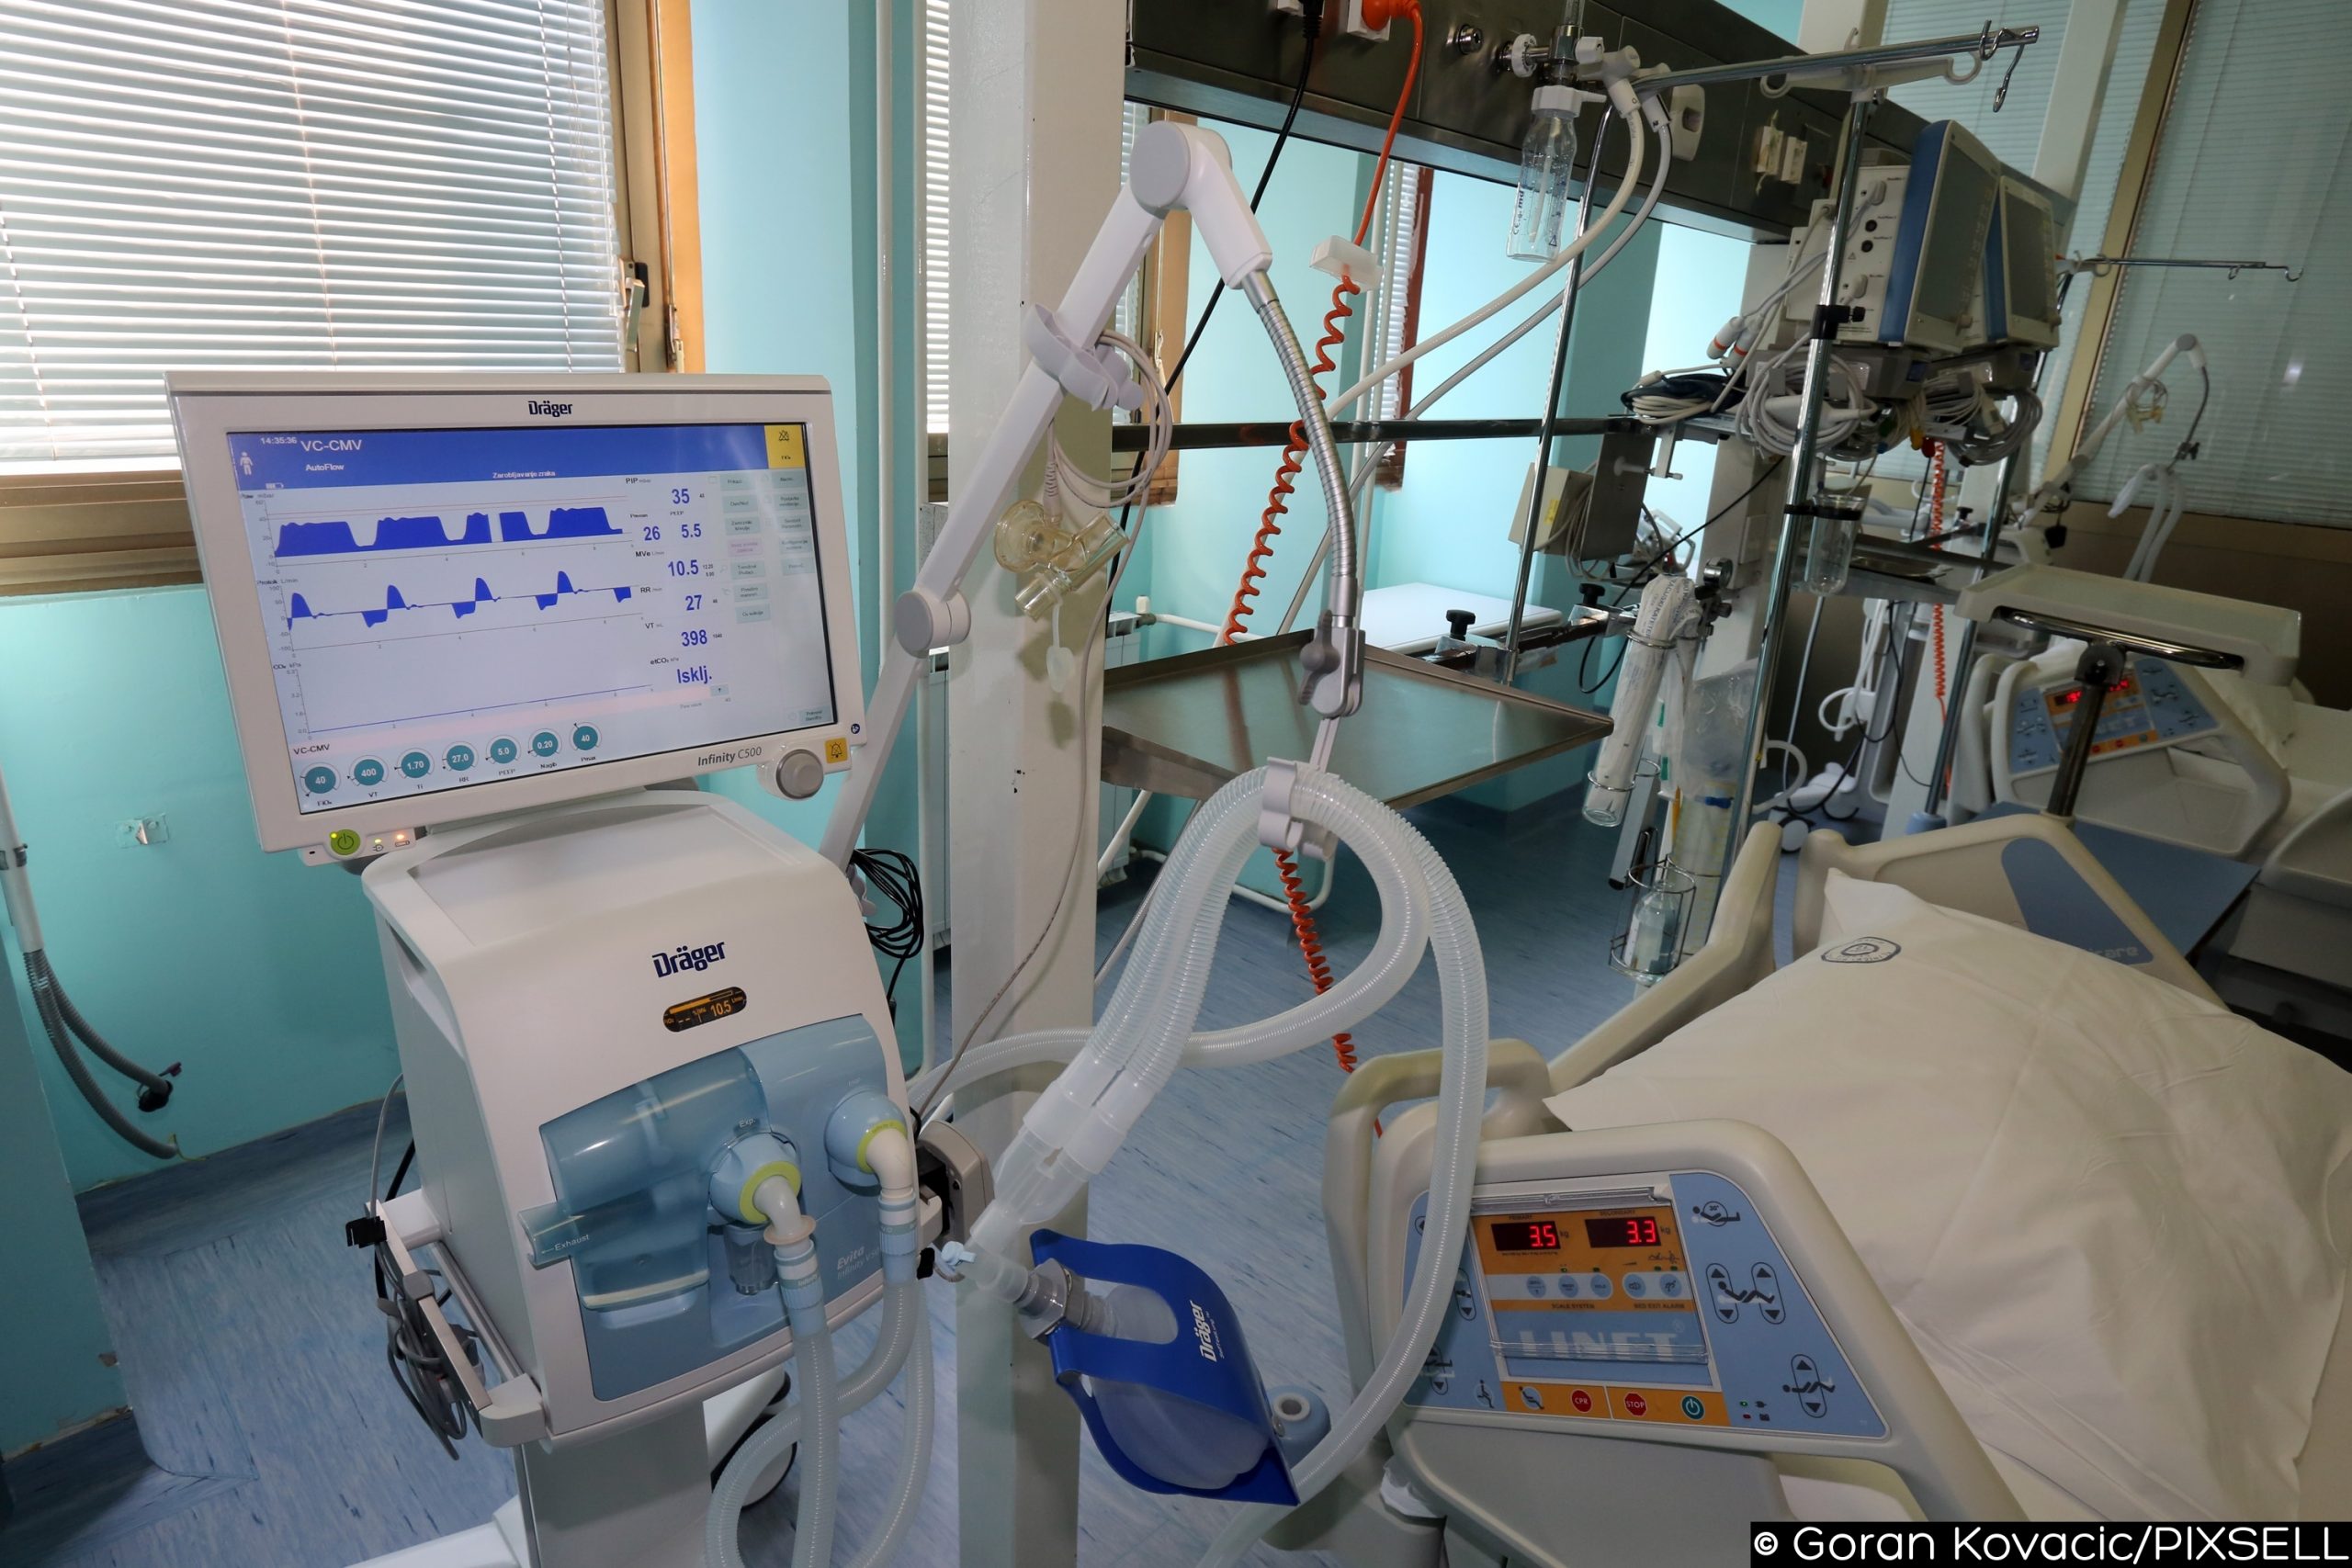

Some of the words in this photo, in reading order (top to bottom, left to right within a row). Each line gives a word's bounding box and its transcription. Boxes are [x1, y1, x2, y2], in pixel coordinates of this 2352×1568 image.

[527, 400, 573, 418] Dräger
[261, 436, 298, 446] 14:35:36
[300, 439, 363, 452] VC-CMV
[305, 462, 345, 472] AutoFlow
[672, 488, 690, 504] 35
[643, 525, 661, 541] 26
[681, 523, 702, 538] 5.5
[668, 558, 699, 577] 10.5
[684, 594, 702, 611] 27
[681, 629, 707, 647] 398
[676, 665, 712, 684] Isklj.
[537, 739, 553, 750] 0.20
[581, 734, 591, 742] 40
[293, 743, 331, 755] VC-CMV
[497, 747, 510, 756] 5.0
[451, 753, 469, 763] 27.0
[697, 751, 736, 767] Infinity
[737, 746, 763, 761] C500
[360, 768, 377, 777] 400
[406, 760, 425, 771] 1.70
[314, 775, 326, 785] 40
[651, 942, 726, 978] Dräger
[710, 999, 732, 1017] 10.5
[739, 1118, 756, 1129] Exp.
[1626, 1219, 1657, 1244] 3.3
[1660, 1226, 1671, 1235] kg
[554, 1234, 590, 1251] Exhaust
[837, 1246, 865, 1270] Evita
[1189, 1299, 1217, 1362] Dräger
[1574, 1396, 1589, 1405] CPR
[1625, 1400, 1645, 1409] STOP
